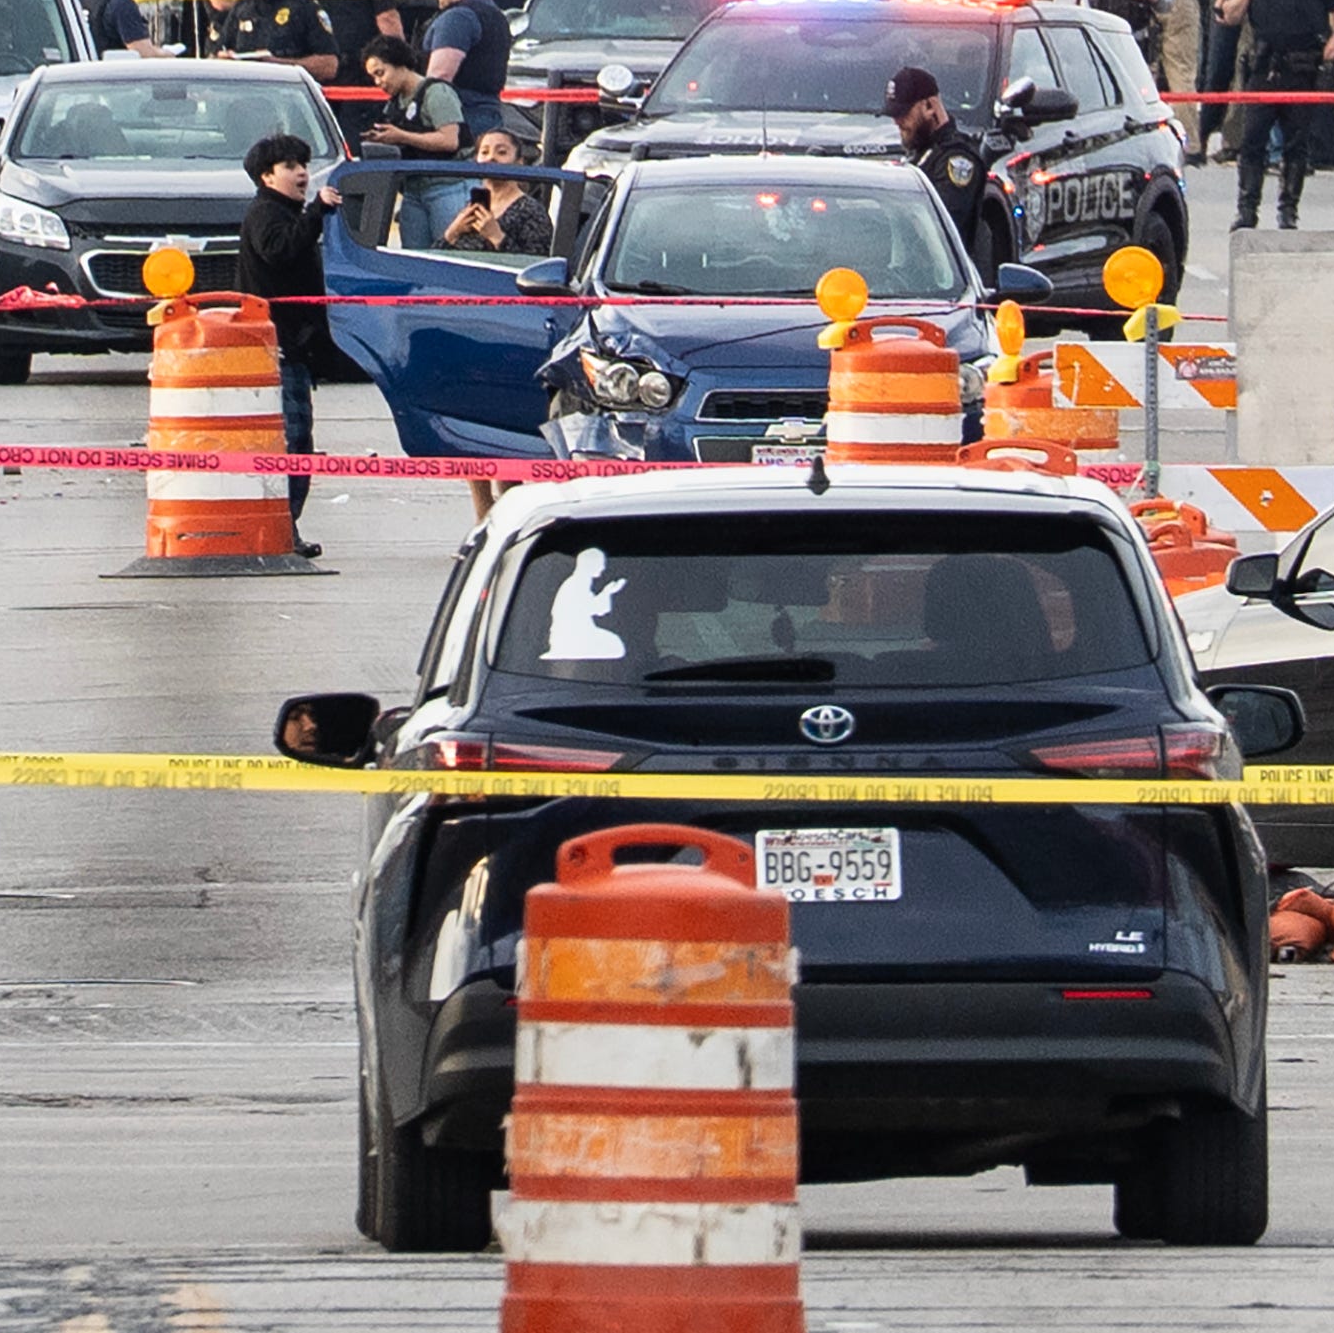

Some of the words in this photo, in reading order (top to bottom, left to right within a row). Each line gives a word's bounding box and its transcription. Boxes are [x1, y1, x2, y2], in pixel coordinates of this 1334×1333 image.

[1046, 172, 1134, 225] POLICE
[40, 449, 72, 464] NOT
[77, 450, 101, 465] DO
[106, 451, 161, 467] SCENE
[167, 452, 219, 469] CRIME
[253, 457, 311, 473] CROSS
[317, 458, 351, 474] NOT
[355, 459, 379, 474] DO
[385, 459, 439, 475] SCENE
[445, 460, 497, 476] CRIME
[1260, 769, 1301, 782] POLICE
[1307, 769, 1331, 782] LINE
[765, 849, 892, 884] BBG-9559
[788, 887, 888, 901] OESCH
